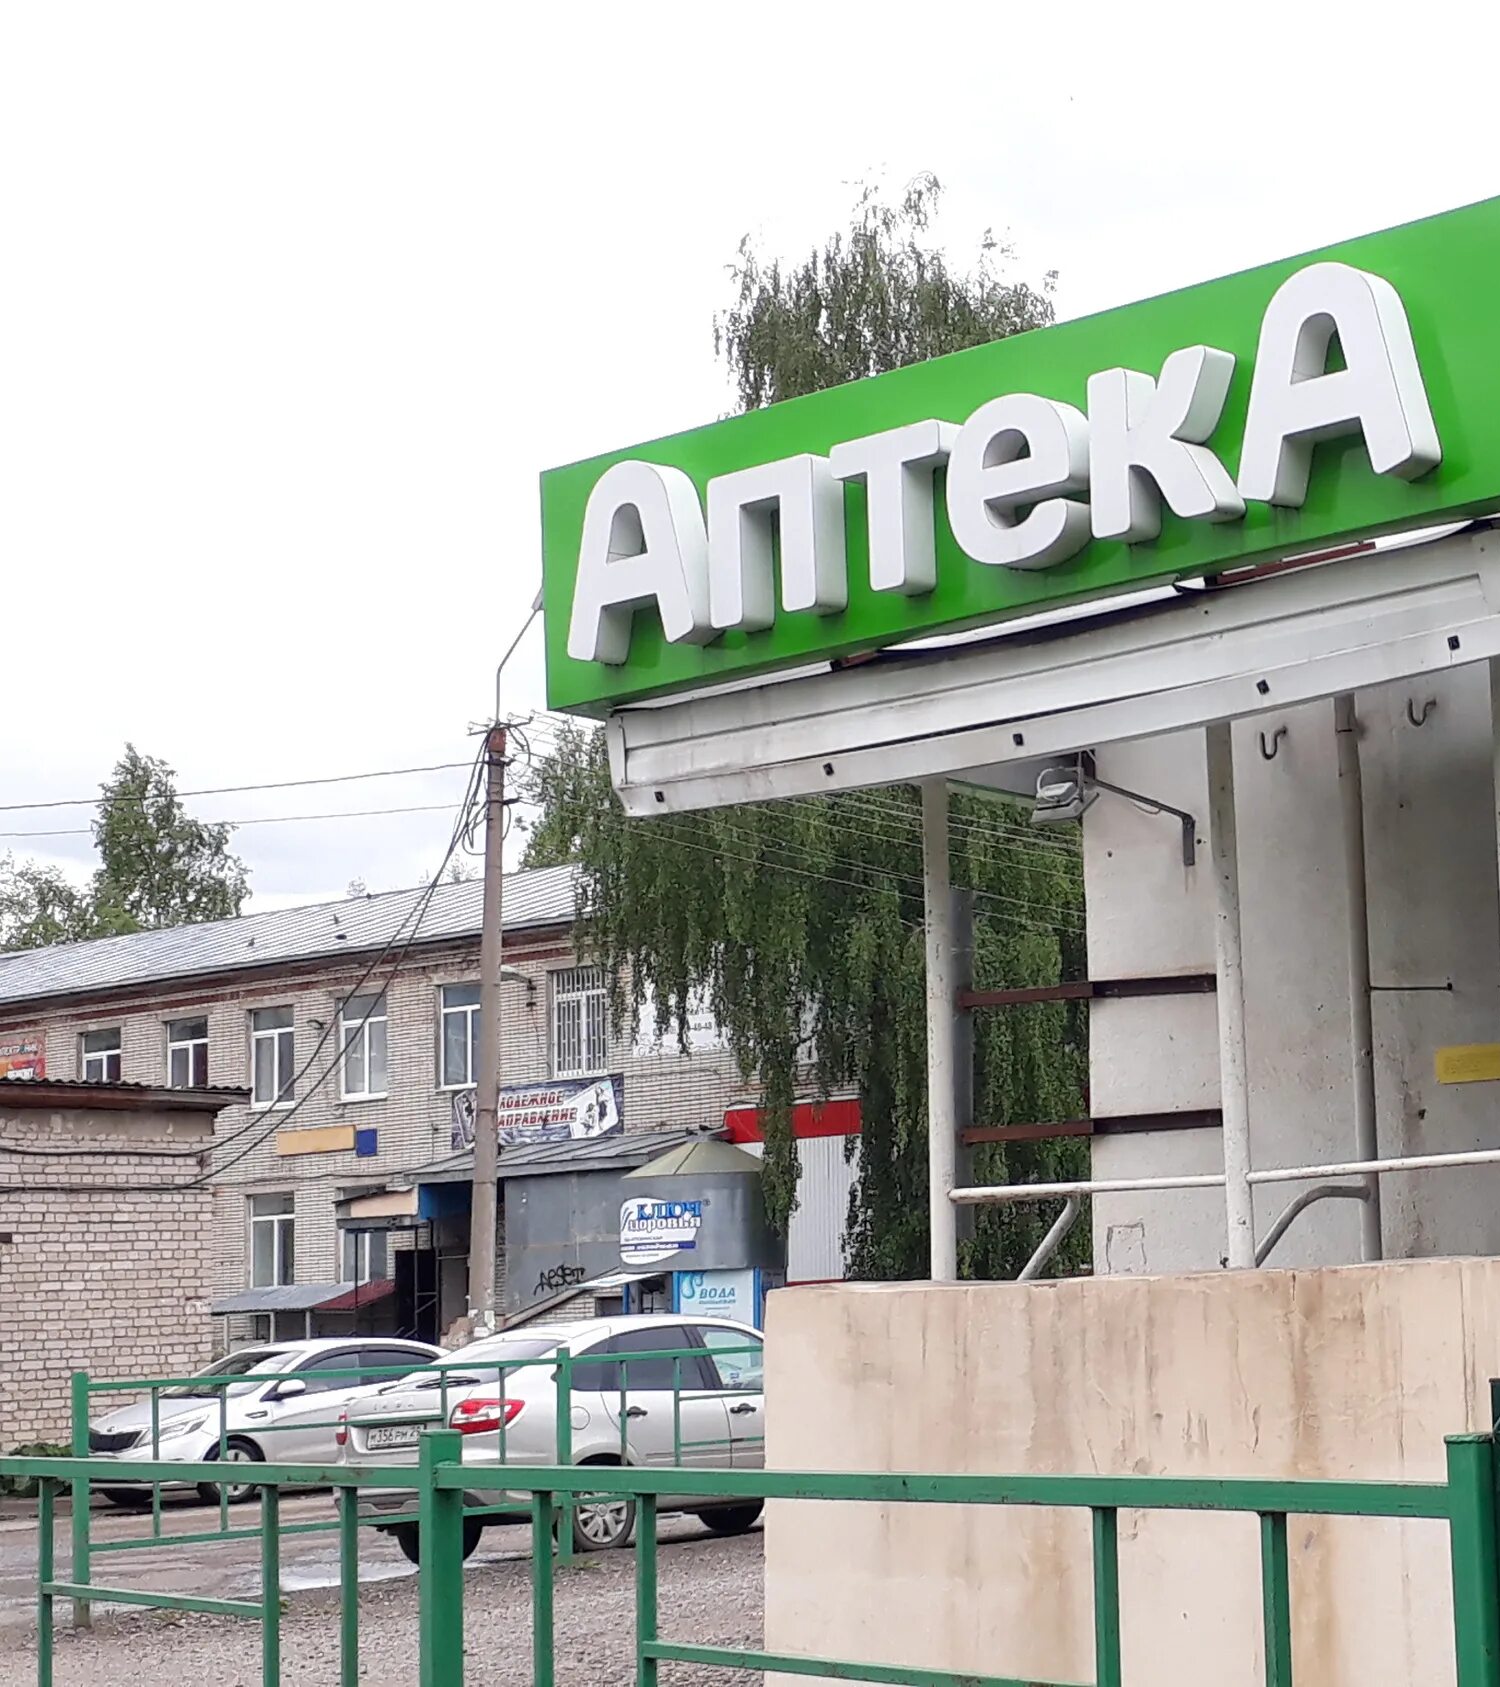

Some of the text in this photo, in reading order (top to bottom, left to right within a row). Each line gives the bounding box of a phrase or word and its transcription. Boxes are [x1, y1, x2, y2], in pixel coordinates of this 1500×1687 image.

[499, 1090, 565, 1109] ЛОДЕЖНОЕ
[497, 1107, 578, 1128] АПРАВЛЕНИЕ
[636, 1201, 702, 1220] КЛЮЧ
[700, 1287, 736, 1299] ВОДА
